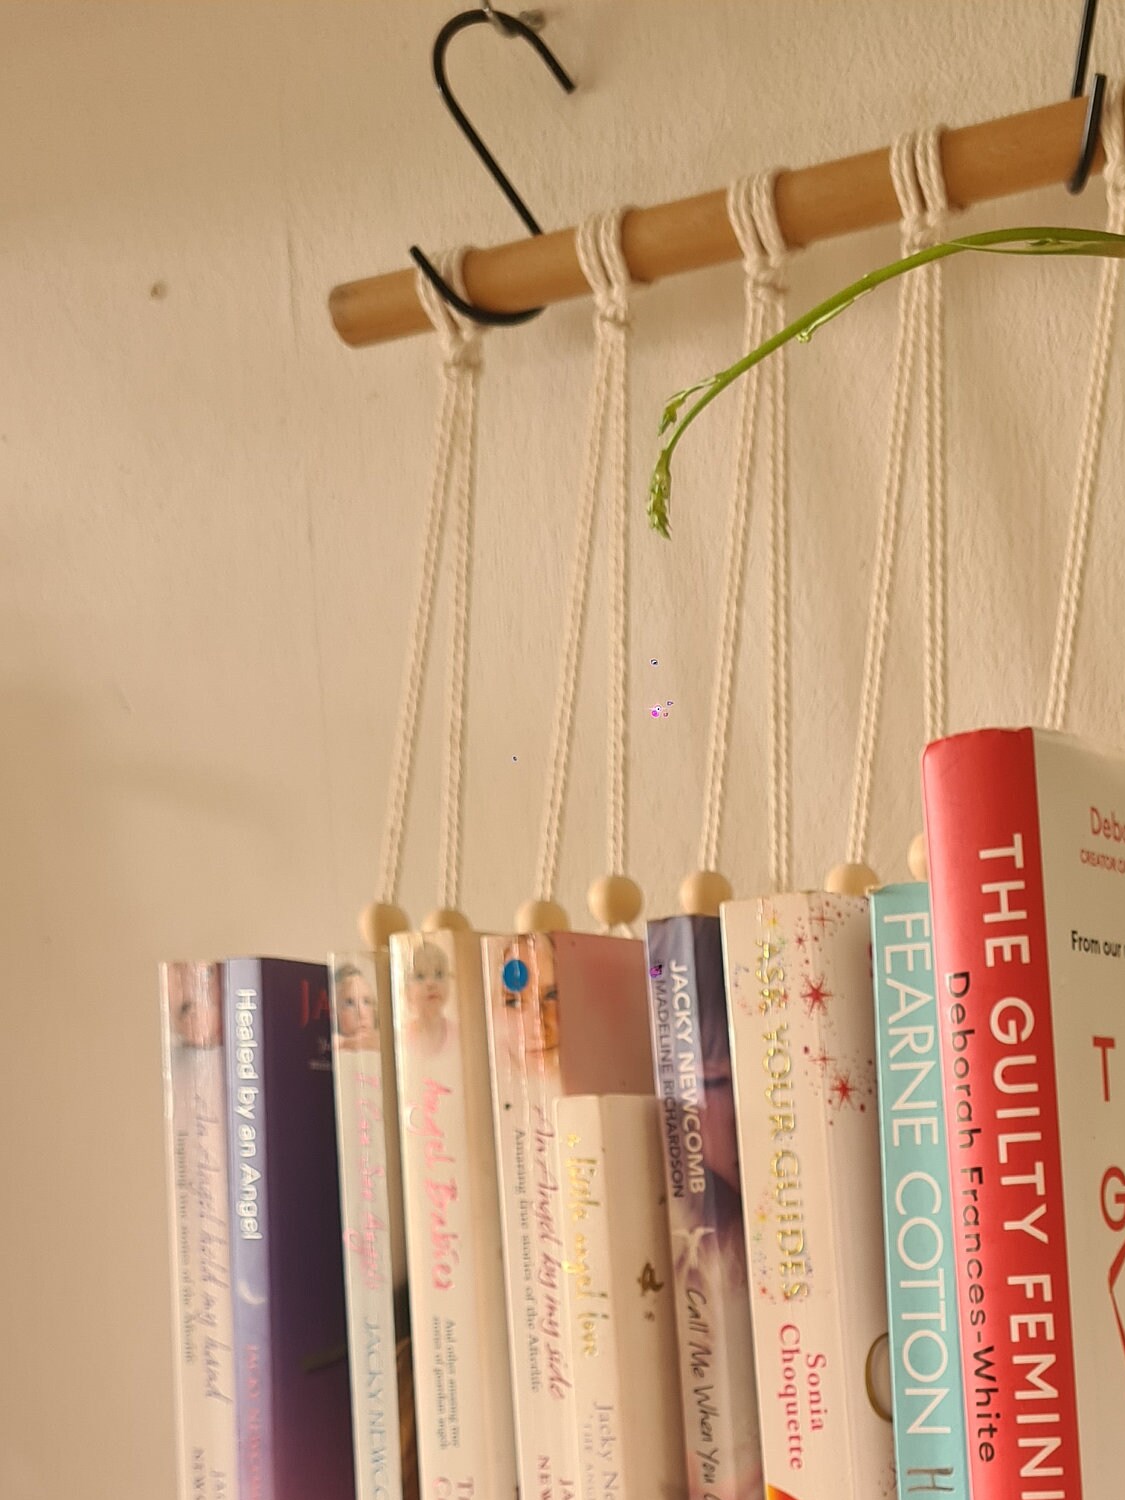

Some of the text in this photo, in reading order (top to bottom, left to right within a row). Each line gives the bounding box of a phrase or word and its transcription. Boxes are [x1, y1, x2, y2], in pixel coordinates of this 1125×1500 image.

[979, 832, 1031, 967] THE
[1071, 929, 1101, 955] From
[1103, 941, 1122, 959] our
[654, 978, 674, 1074] MADELINE
[882, 911, 939, 1147] FEARNE
[235, 988, 263, 1241] Healed by an Angel
[669, 959, 707, 1194] JACKY NEWCOMB
[761, 1022, 797, 1141] YOUR
[989, 996, 1050, 1245] GUILTY
[406, 1077, 462, 1292] Angel Babies
[514, 1128, 529, 1195] Amazing
[662, 1080, 685, 1199] RICHARDSON
[518, 1198, 532, 1230] true
[521, 1234, 536, 1282] stories
[531, 1103, 573, 1400] An Angel by my side
[770, 1150, 810, 1300] GUIDES
[945, 970, 1002, 1464] Deborah Frances-White
[524, 1286, 538, 1302] of
[526, 1306, 539, 1330] the
[685, 1286, 713, 1333] Call
[894, 1171, 952, 1436] COTTON
[363, 1317, 387, 1403] JACKY
[687, 1341, 713, 1379] Me
[778, 1324, 804, 1471] Choquette
[805, 1353, 827, 1432] Sonia
[592, 1401, 616, 1462] Jacky
[694, 1384, 718, 1443] When
[696, 1448, 721, 1485] You
